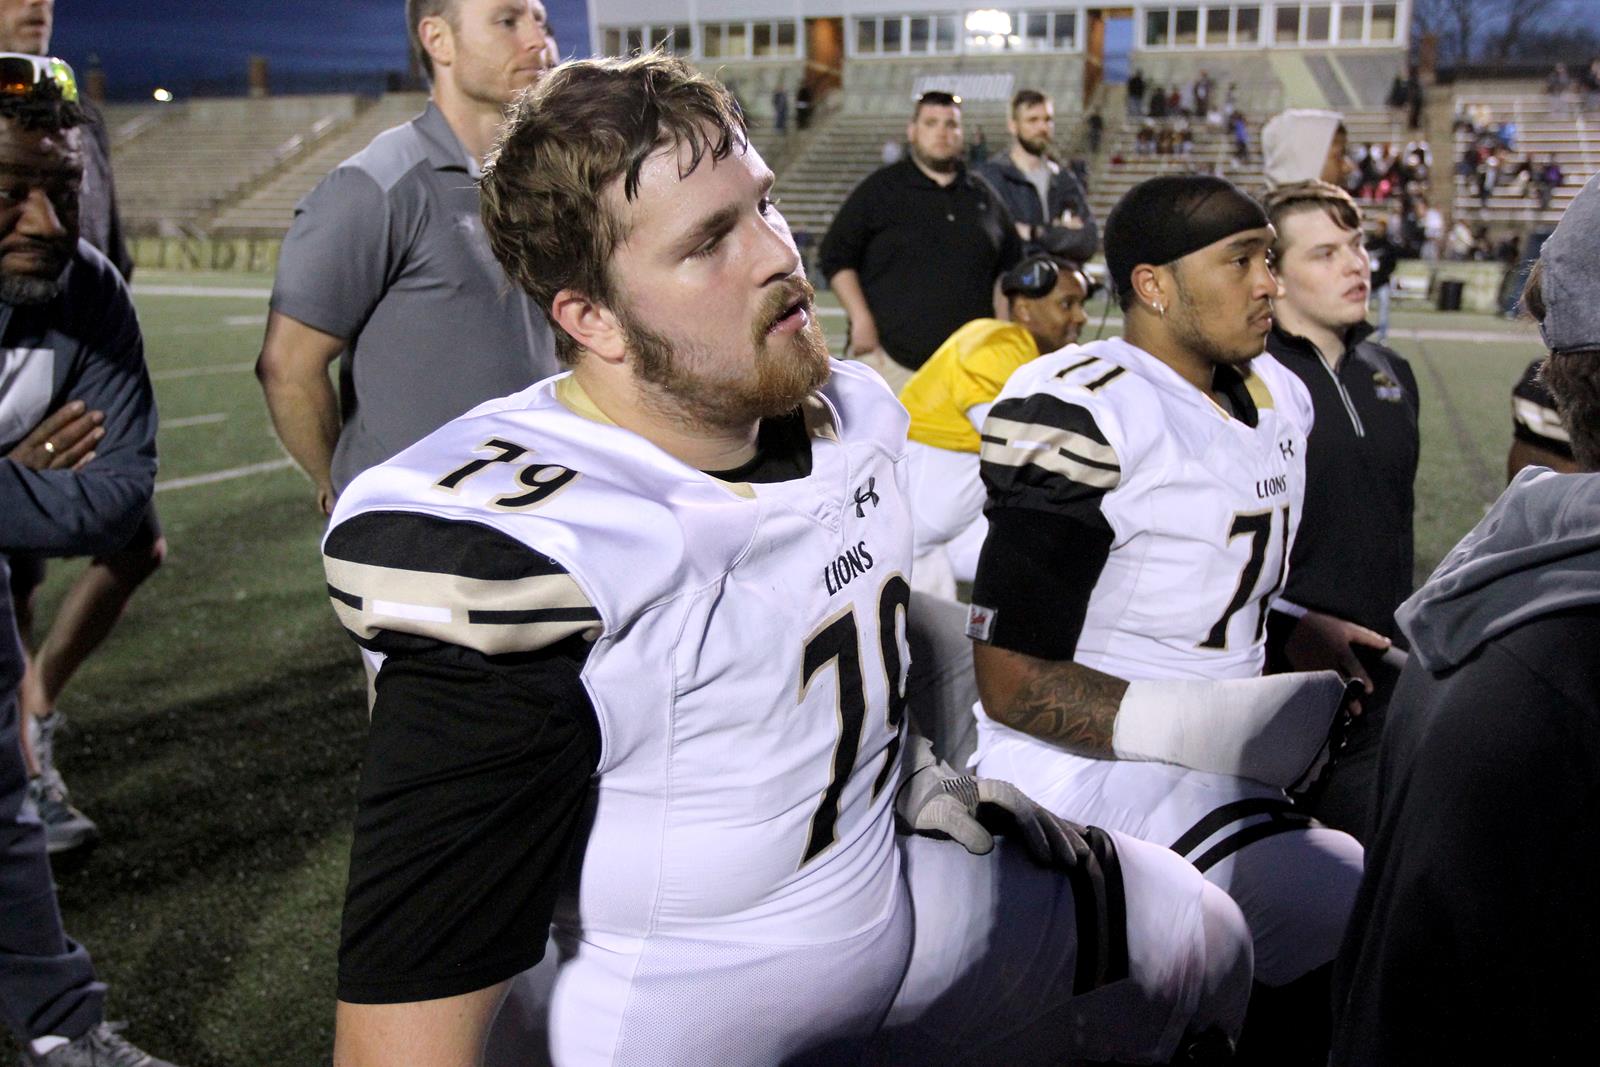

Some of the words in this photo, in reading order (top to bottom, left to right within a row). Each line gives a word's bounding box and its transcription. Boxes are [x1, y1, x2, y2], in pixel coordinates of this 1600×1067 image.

[430, 435, 583, 513] 79
[1256, 474, 1286, 499] LIONS
[824, 540, 874, 597] LIONS
